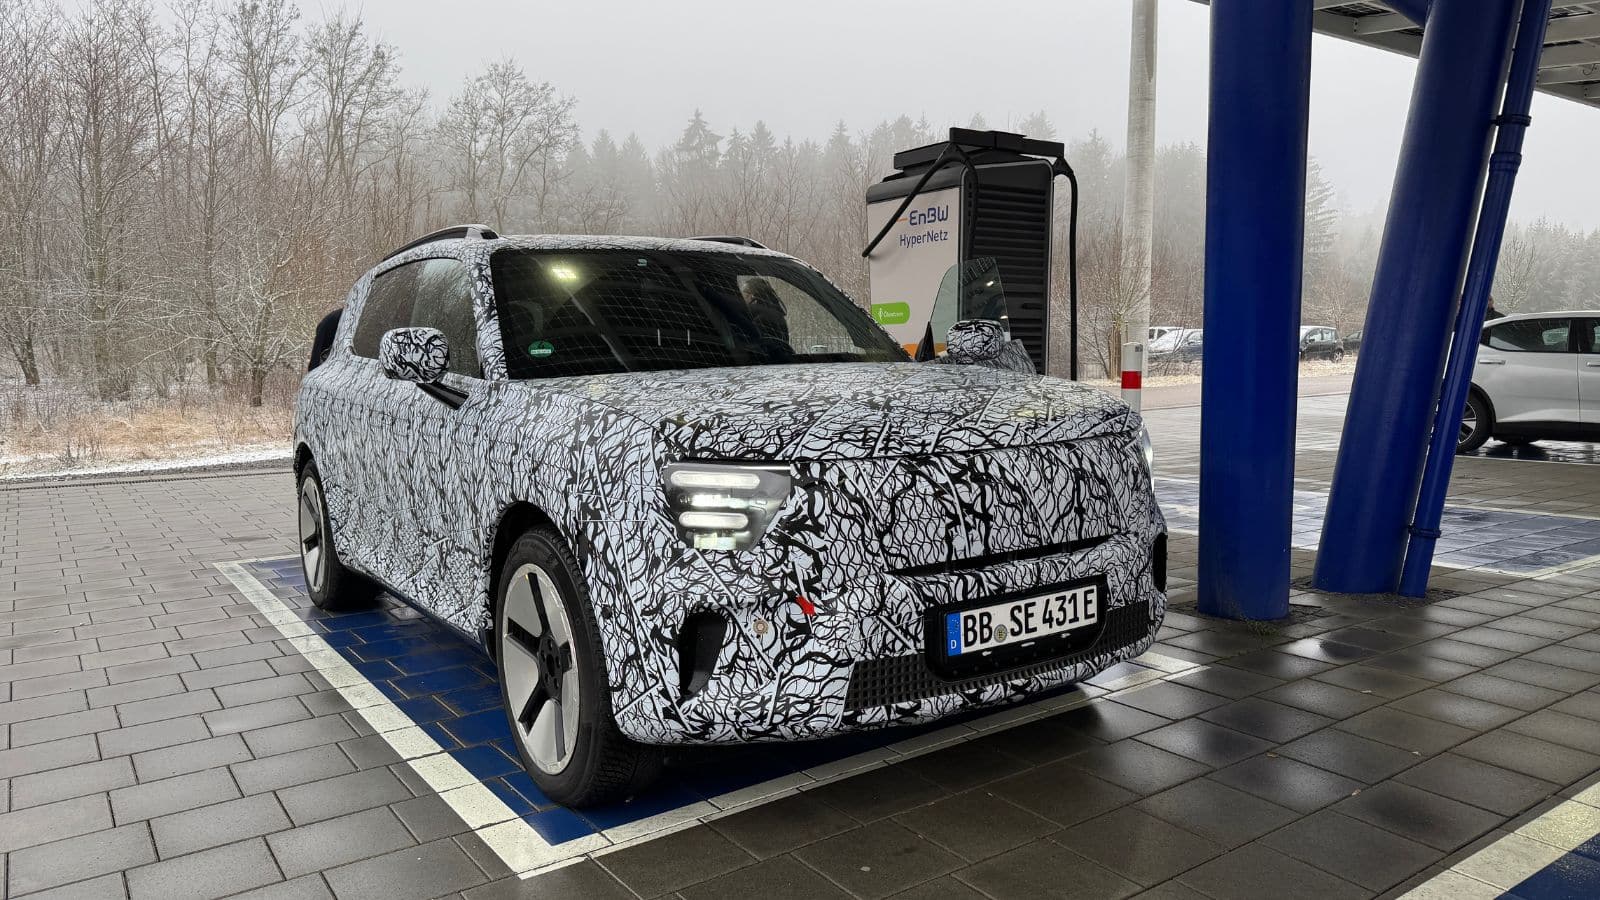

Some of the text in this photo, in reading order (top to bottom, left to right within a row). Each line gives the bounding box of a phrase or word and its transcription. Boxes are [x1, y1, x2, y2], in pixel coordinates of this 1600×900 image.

[909, 205, 949, 226] EnBW
[900, 230, 948, 248] HyperNetz
[963, 611, 993, 648] BB
[1009, 601, 1037, 637] SE
[951, 640, 957, 650] D
